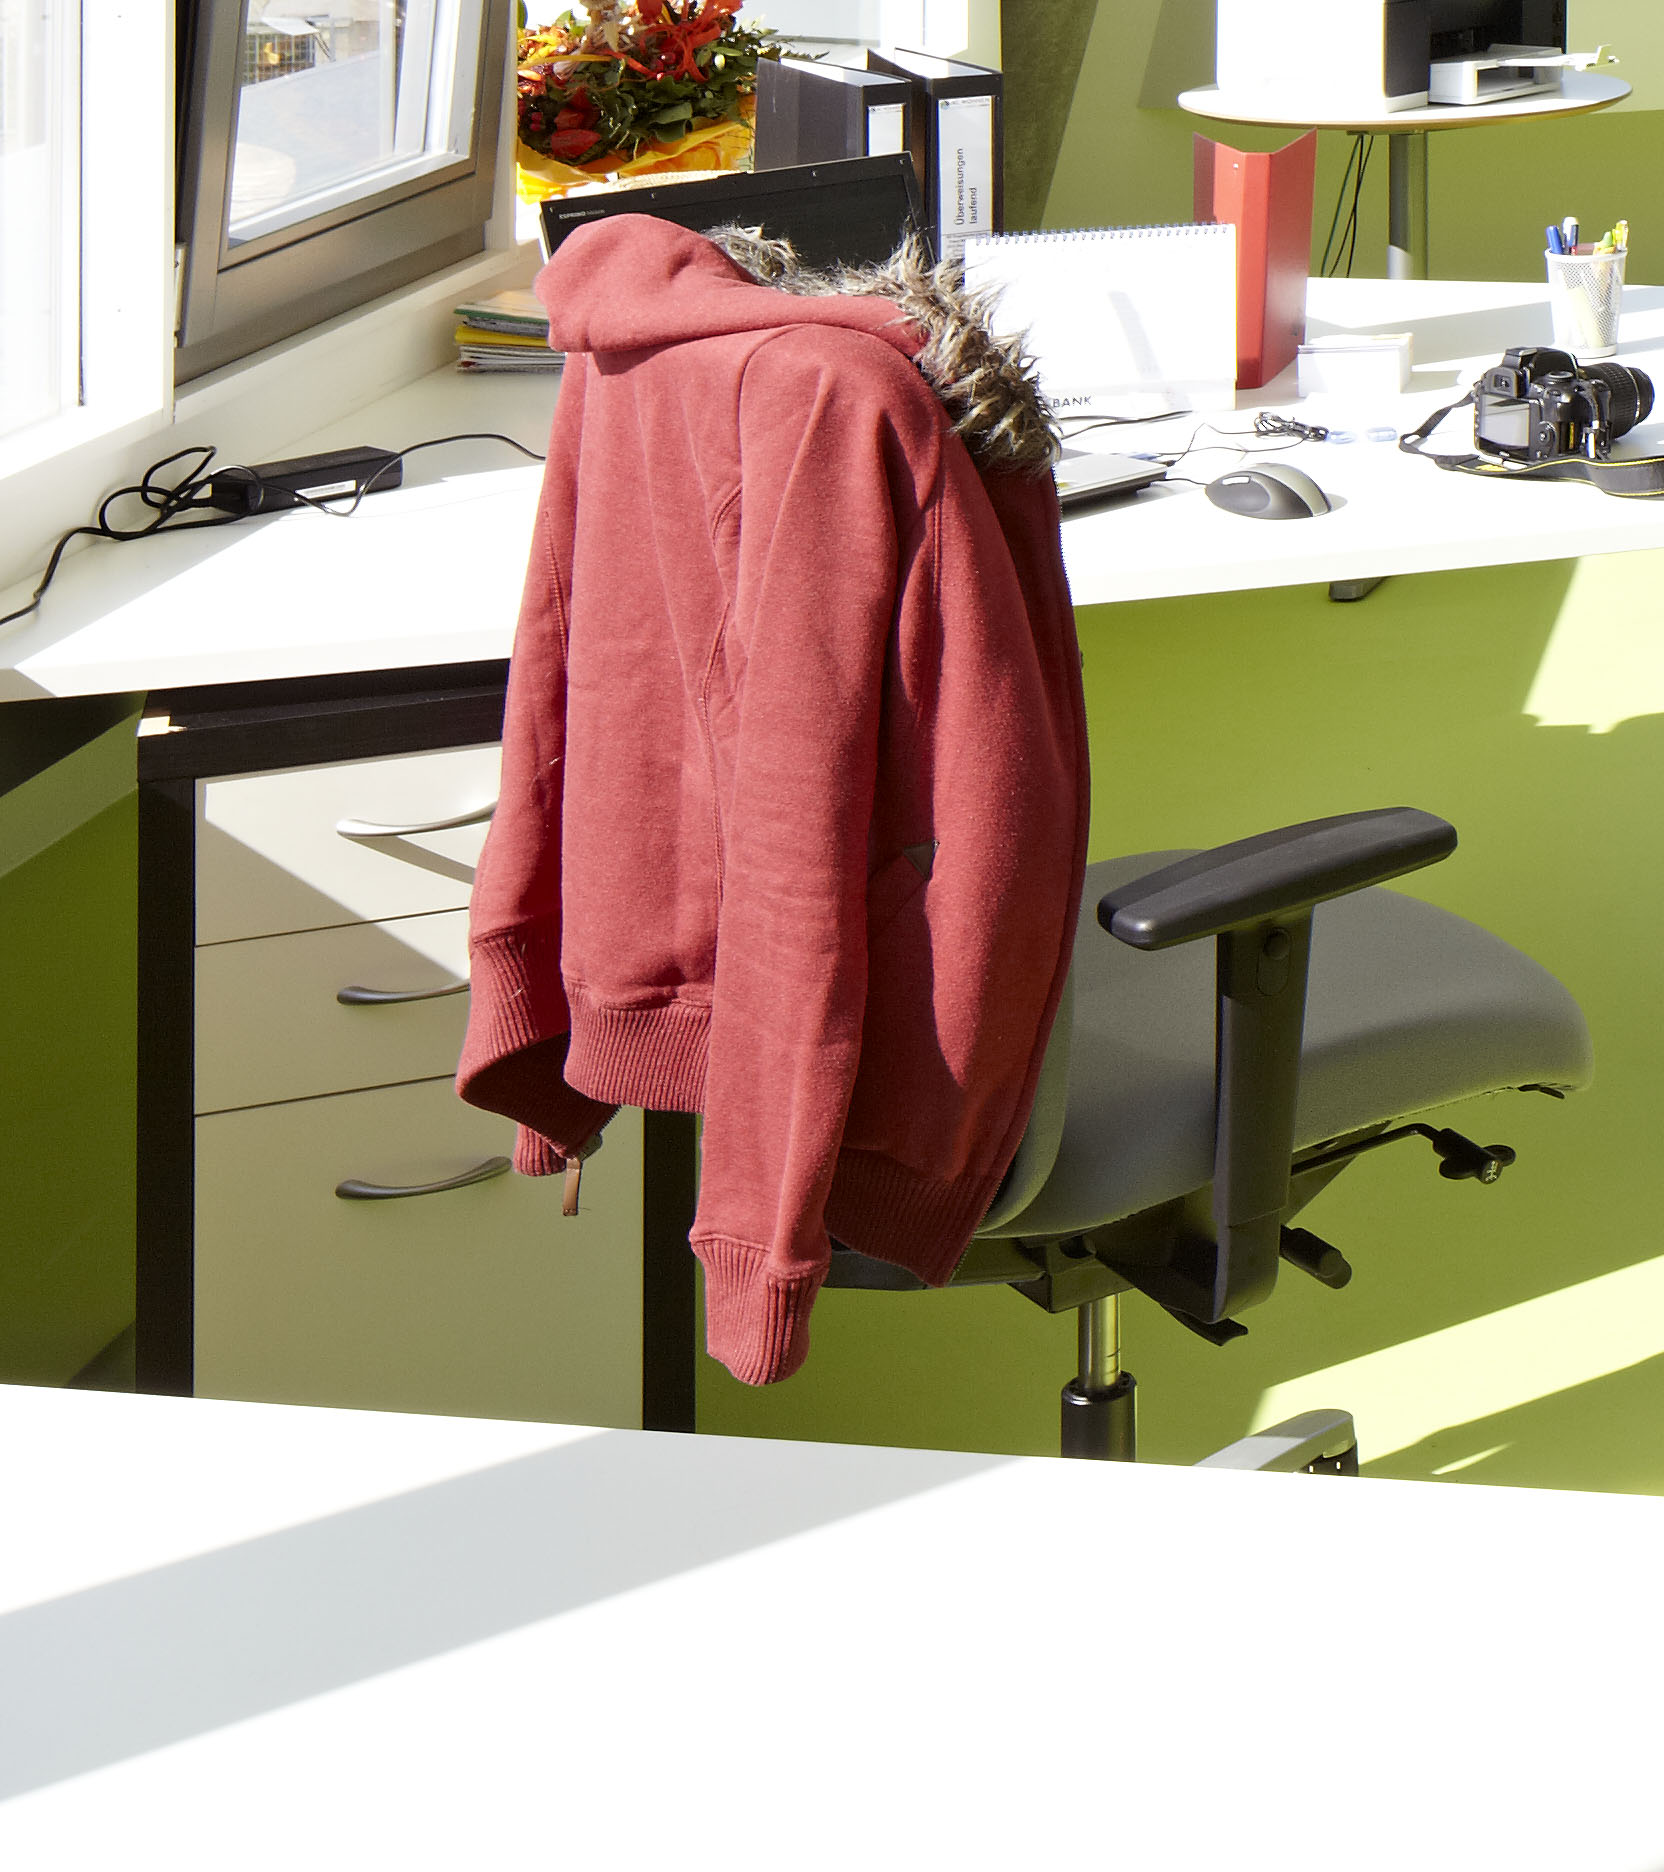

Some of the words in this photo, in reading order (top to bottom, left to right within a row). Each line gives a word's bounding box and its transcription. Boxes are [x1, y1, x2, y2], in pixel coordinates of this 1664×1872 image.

[954, 148, 967, 226] Überweisungen
[969, 187, 978, 225] laufend
[1052, 395, 1093, 409] BANK
